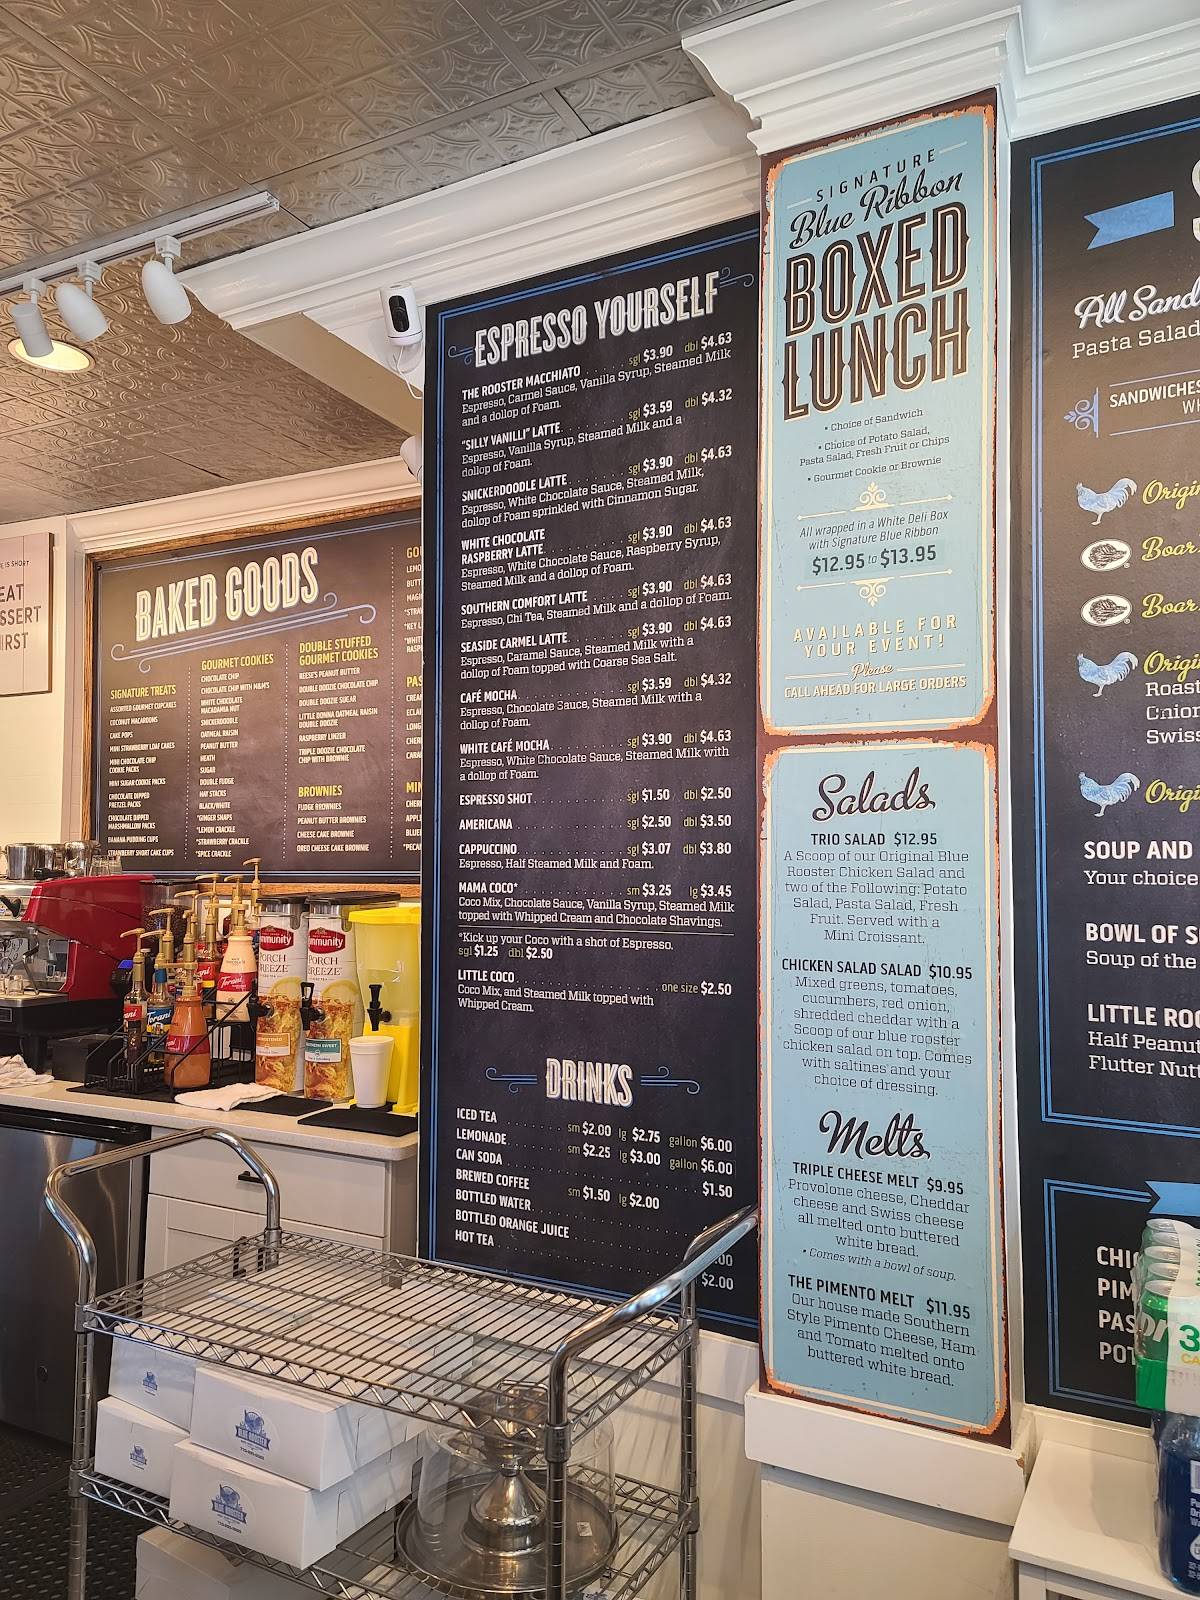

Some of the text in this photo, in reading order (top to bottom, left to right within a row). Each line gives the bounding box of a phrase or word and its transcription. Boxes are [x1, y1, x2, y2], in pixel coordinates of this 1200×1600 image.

[816, 148, 936, 202] SIGNATURE
[790, 170, 963, 250] Blue Ribbon
[784, 201, 970, 338] BOXED
[476, 272, 719, 367] ESPRESSO YOURSELF
[1074, 290, 1127, 329] All
[782, 288, 970, 420] LUNCH
[1072, 336, 1131, 359] Pasta
[462, 332, 732, 400] THE ROOSTER MACCHIATO sgl $3.90 dbl $4.63
[462, 349, 731, 414] Espresso, Carmel Sauce, Vanilla Syrup, Steamed Milk
[532, 423, 561, 437] LATTE
[831, 408, 923, 432] Choice of Sandwich
[462, 474, 568, 501] SNICKERDOODLE LATTE
[800, 528, 812, 538] All
[816, 522, 854, 537] wrapped
[858, 520, 866, 530] in
[878, 515, 905, 528] White
[908, 512, 928, 524] Deli
[931, 510, 948, 522] Box
[812, 544, 936, 576] $12.95 to $13.95
[136, 547, 318, 642] BAKED GOODS
[793, 614, 958, 642] AVAILABLE FOR
[300, 636, 371, 653] DOUBLE STUFFED
[804, 634, 944, 658] YOUR EVENT!
[201, 654, 273, 671] GOURMET COOKIES
[300, 648, 378, 666] GOURMET COOKIES
[850, 662, 894, 681] Please
[111, 685, 176, 700] SIGNATURE TREATS
[460, 690, 517, 703] CAFÉ MOCHA
[784, 676, 966, 698] CALL AHEAD FOR LARGE ORDERS
[299, 785, 342, 797] BROWNIES
[812, 767, 936, 822] Salads
[459, 844, 516, 855] CAPPUCCINO
[811, 832, 937, 846] TRIO SALAD $12.95
[1084, 841, 1193, 859] SOUP AND
[459, 858, 654, 869] Espresso, Half Steamed Milk and Foam.
[784, 850, 969, 864] A Scoop of our Original Blue
[1084, 871, 1198, 886] Your choice
[459, 882, 486, 894] MAMA
[627, 886, 640, 895] sm
[642, 884, 672, 896] $3.25
[690, 886, 698, 898] lg
[700, 884, 732, 897] $3.45
[1086, 923, 1178, 944] BOWL OF
[782, 959, 972, 979] CHICKEN SALAD SALAD $10.95
[1087, 951, 1196, 969] Soup of the
[147, 1007, 171, 1023] Torani
[1088, 1004, 1157, 1026] LITTLE
[1088, 1031, 1128, 1048] Half
[546, 1058, 633, 1108] DRINKS
[456, 1128, 506, 1144] LEMONADE
[457, 1108, 732, 1152] ICED TEA sm $2.00 lg $2.75 gallon $6.00
[819, 1110, 930, 1160] Melts
[456, 1149, 732, 1198] CAN SODA $1.50
[456, 1169, 529, 1190] BREWED COFFEE
[793, 1162, 964, 1194] TRIPLE CHEESE MELT $9.95
[456, 1210, 569, 1238] BOTTLED ORANGE JUICE
[788, 1274, 970, 1319] THE PIMENTO MELT $11.95
